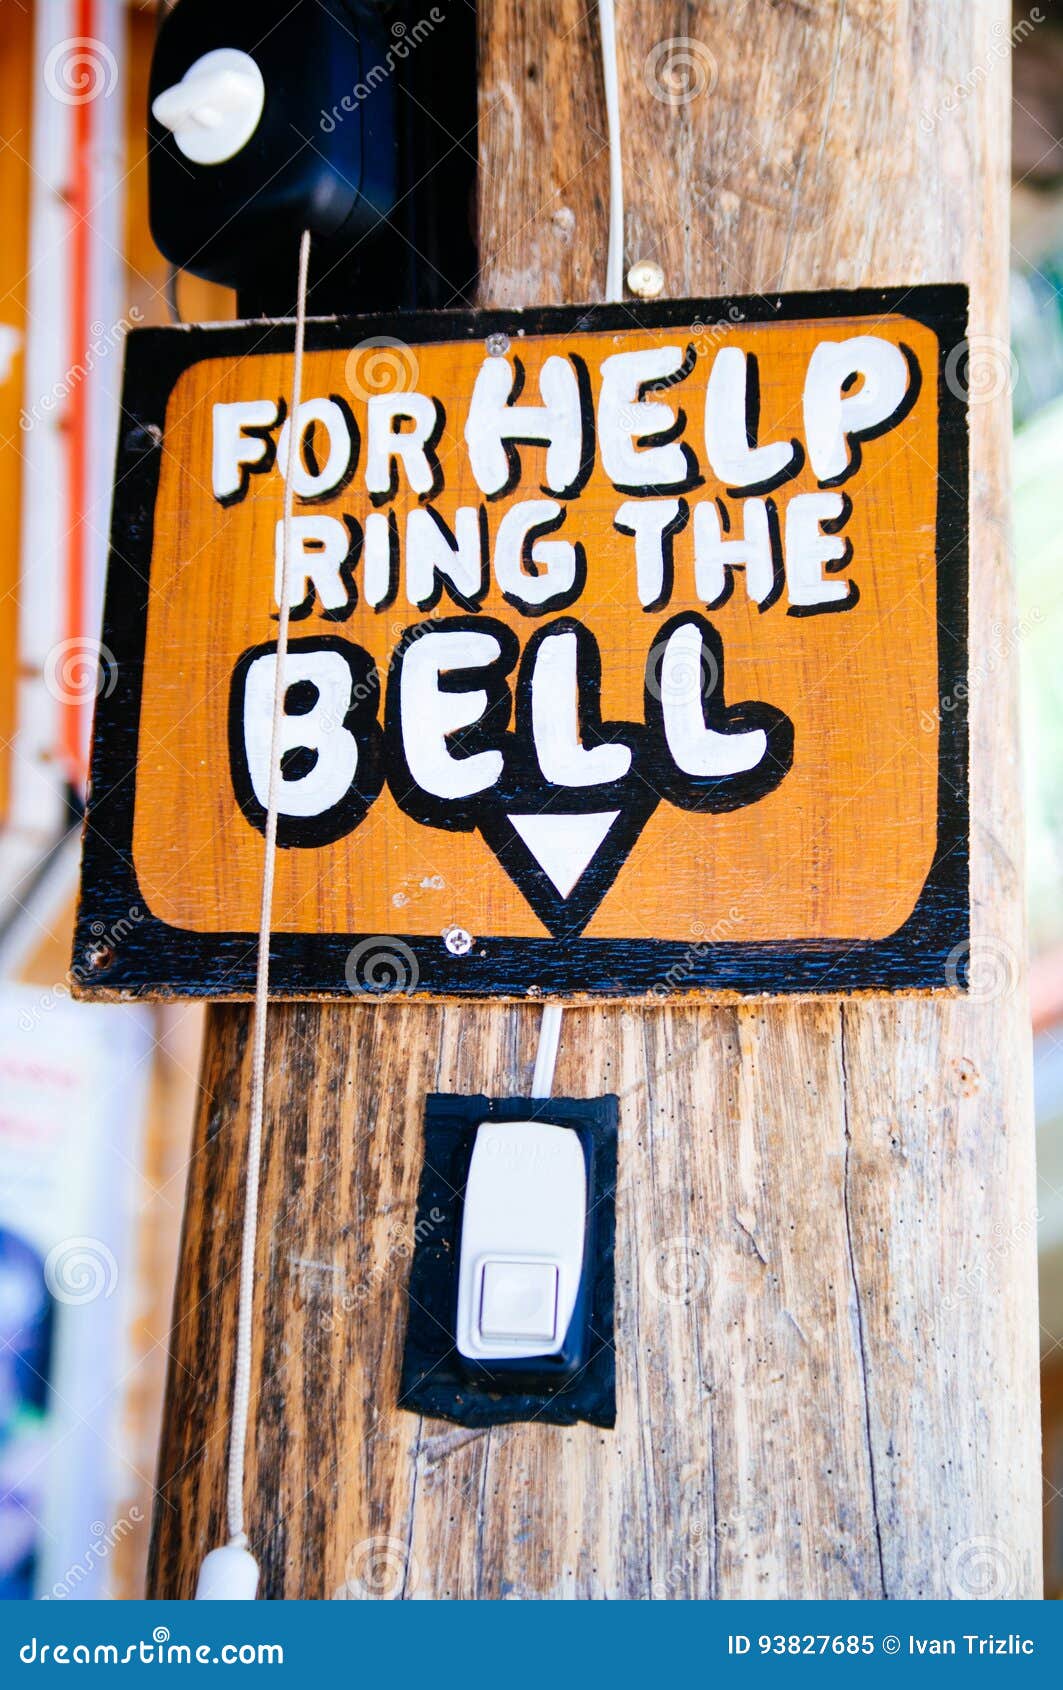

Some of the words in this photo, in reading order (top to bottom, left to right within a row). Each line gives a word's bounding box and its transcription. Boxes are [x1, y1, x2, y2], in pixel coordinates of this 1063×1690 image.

[211, 392, 445, 507] FOR
[464, 336, 921, 498] HELP
[272, 500, 588, 618] RING
[613, 493, 859, 616] THE
[240, 620, 769, 820] BELL
